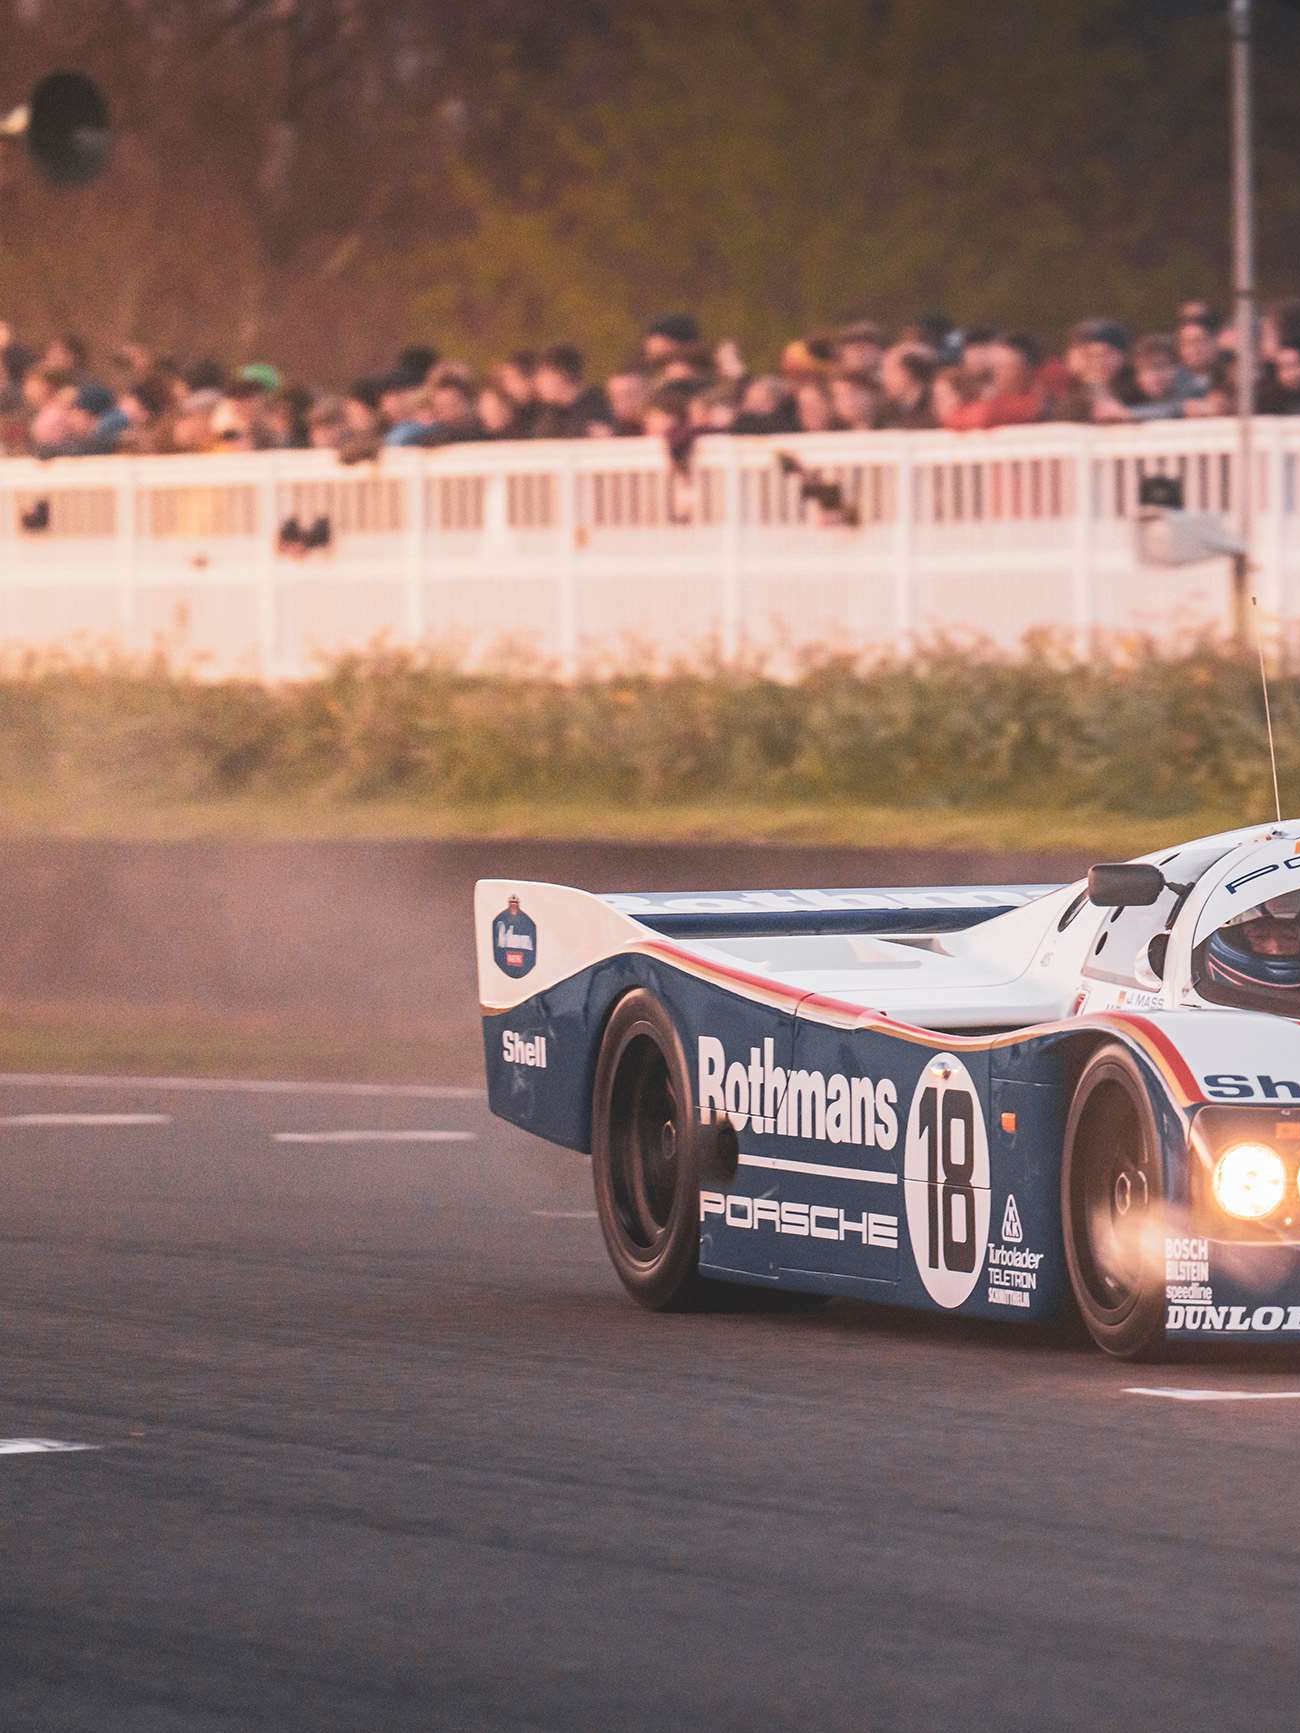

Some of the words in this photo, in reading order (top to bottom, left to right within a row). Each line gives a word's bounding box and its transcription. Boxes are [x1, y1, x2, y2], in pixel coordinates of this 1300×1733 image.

[502, 1029, 548, 1069] Shell
[697, 1035, 899, 1151] Rothmans
[918, 1086, 976, 1274] 18
[700, 1190, 899, 1249] PORSCHE
[988, 1243, 1044, 1269] Turbolader
[1165, 1238, 1209, 1261] BOSCH
[987, 1267, 1037, 1290] TELETRON
[1165, 1260, 1210, 1282] BILSTEIN
